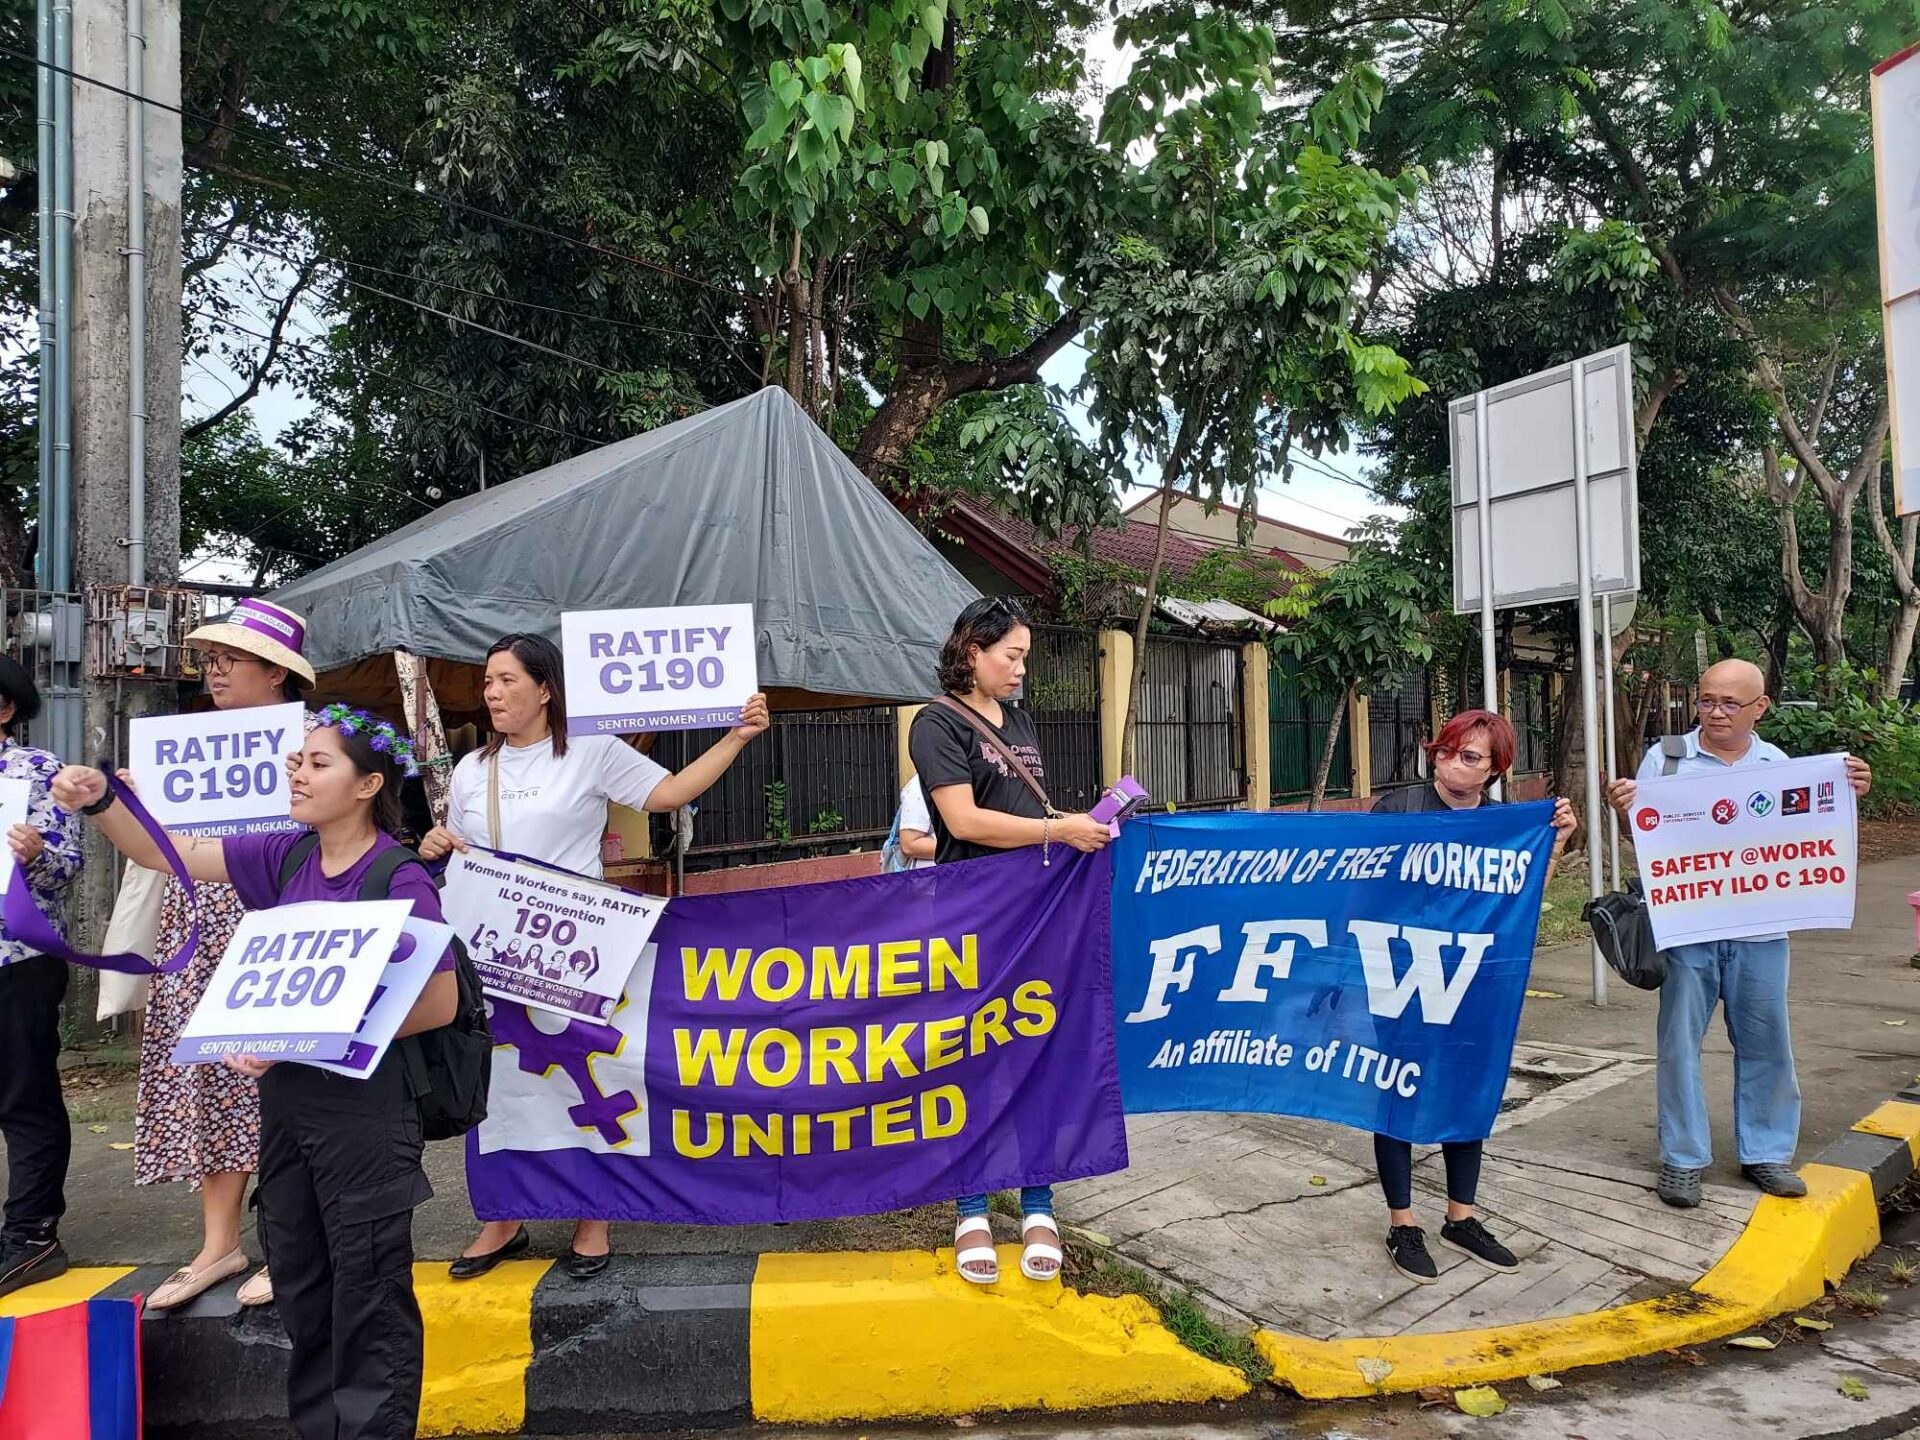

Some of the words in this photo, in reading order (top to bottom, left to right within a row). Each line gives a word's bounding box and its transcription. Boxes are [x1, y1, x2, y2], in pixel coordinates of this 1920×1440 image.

[589, 626, 732, 658] RATIFY
[599, 656, 724, 694] C190
[597, 717, 646, 730] SENTRO
[649, 714, 697, 726] WOMEN
[707, 711, 735, 723] ITUC
[155, 728, 285, 766] RATIFY
[163, 761, 277, 803] C190
[192, 825, 237, 838] WOMEN
[246, 820, 299, 834] NAGKAISA
[1645, 815, 1658, 826] PSI
[1135, 848, 1299, 895] FEDERATION
[1293, 849, 1330, 883] OF
[1326, 844, 1401, 881] FREE
[1399, 842, 1532, 895] WORKERS
[1650, 850, 1734, 878] SAFETY
[1741, 839, 1836, 865] @WORK
[463, 860, 511, 881] Women
[515, 874, 568, 897] Workers
[572, 892, 597, 907] say,
[601, 898, 651, 919] RATIFY
[1650, 879, 1724, 906] RATIFY
[1731, 874, 1769, 894] ILO
[1775, 871, 1791, 888] C
[1799, 866, 1846, 886] 190
[498, 887, 523, 902] ILO
[527, 895, 606, 926] Convention
[238, 927, 380, 965] RATIFY
[514, 908, 577, 946] 190
[226, 965, 346, 1010] C190
[512, 974, 523, 982] OF
[524, 977, 544, 988] FREE
[545, 983, 584, 998] WORKERS
[680, 934, 979, 1002] WOMEN
[1124, 919, 1495, 1025] FFW
[507, 983, 546, 1000] NETWORK
[547, 994, 571, 1007] (FWN)
[198, 1041, 242, 1055] SENTRO
[242, 1040, 286, 1053] WOMEN
[295, 1040, 318, 1052] IUF
[673, 980, 1057, 1088] WORKERS
[1148, 1039, 1183, 1069] An
[1188, 1029, 1292, 1067] affiliate
[1305, 1040, 1340, 1074] of
[1343, 1044, 1421, 1099] ITUC
[671, 1084, 967, 1159] UNITED
